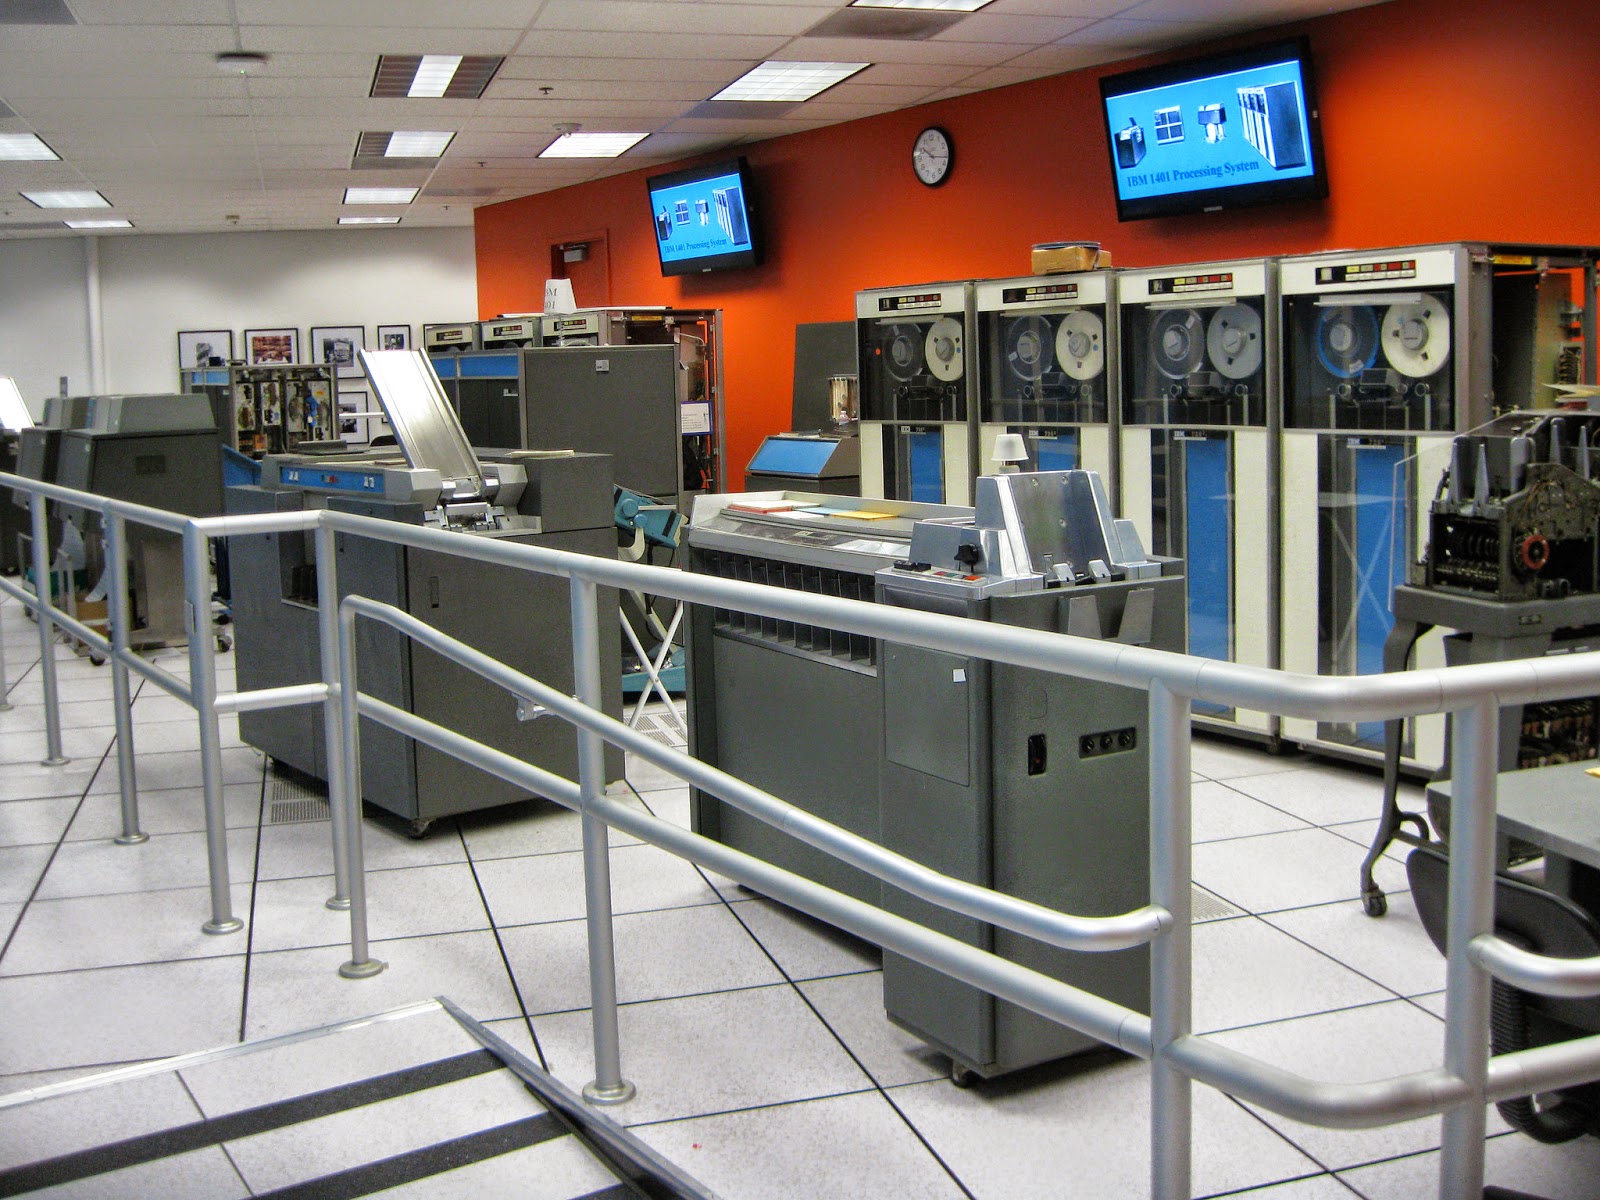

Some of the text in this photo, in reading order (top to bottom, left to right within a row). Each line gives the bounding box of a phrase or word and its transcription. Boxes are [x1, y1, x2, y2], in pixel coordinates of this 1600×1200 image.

[1127, 160, 1260, 187] IBM 1401 Processing System
[687, 241, 710, 251] Processing
[710, 239, 727, 248] System
